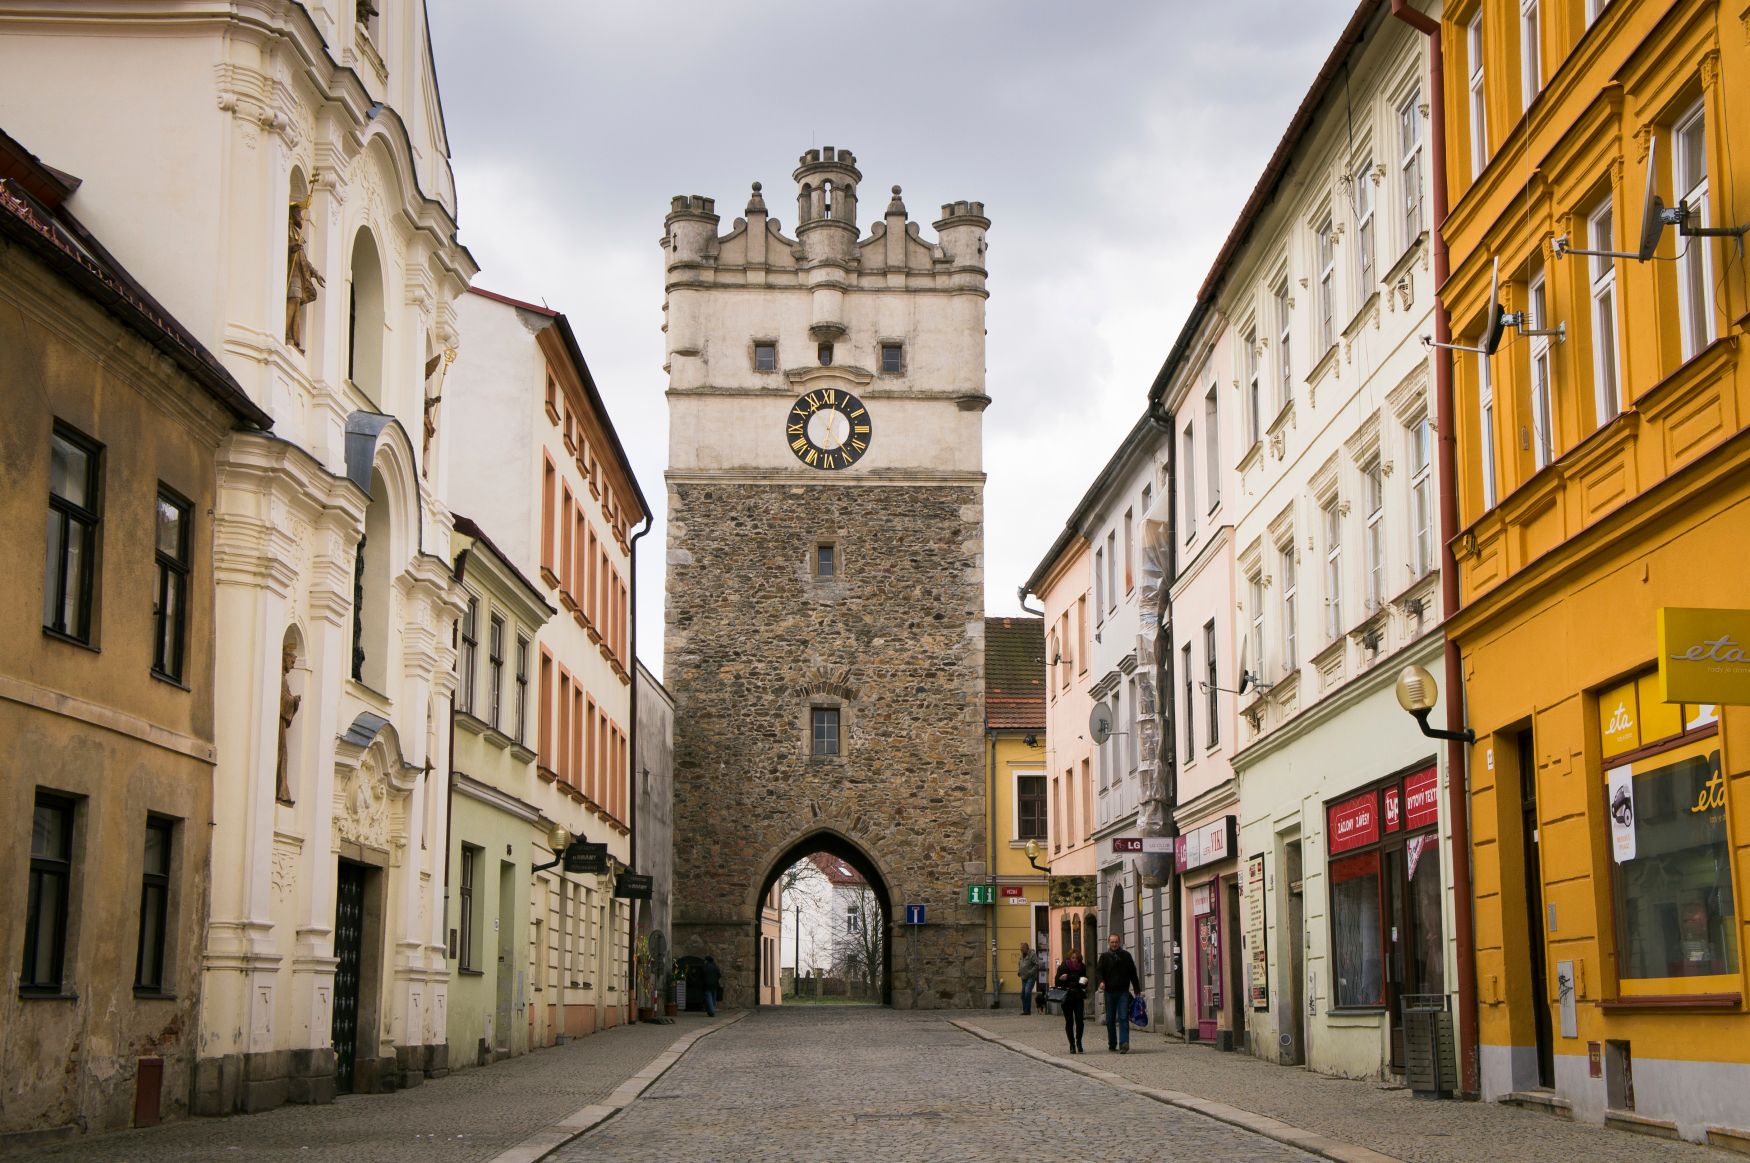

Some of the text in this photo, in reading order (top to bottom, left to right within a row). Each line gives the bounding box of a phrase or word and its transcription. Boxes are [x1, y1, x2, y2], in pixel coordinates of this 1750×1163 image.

[822, 390, 834, 404] XII
[841, 395, 850, 408] I
[793, 406, 808, 419] X
[850, 408, 864, 418] II
[842, 451, 853, 465] V
[1671, 634, 1750, 662] eta
[1605, 702, 1633, 735] eta
[1181, 844, 1187, 863] LG
